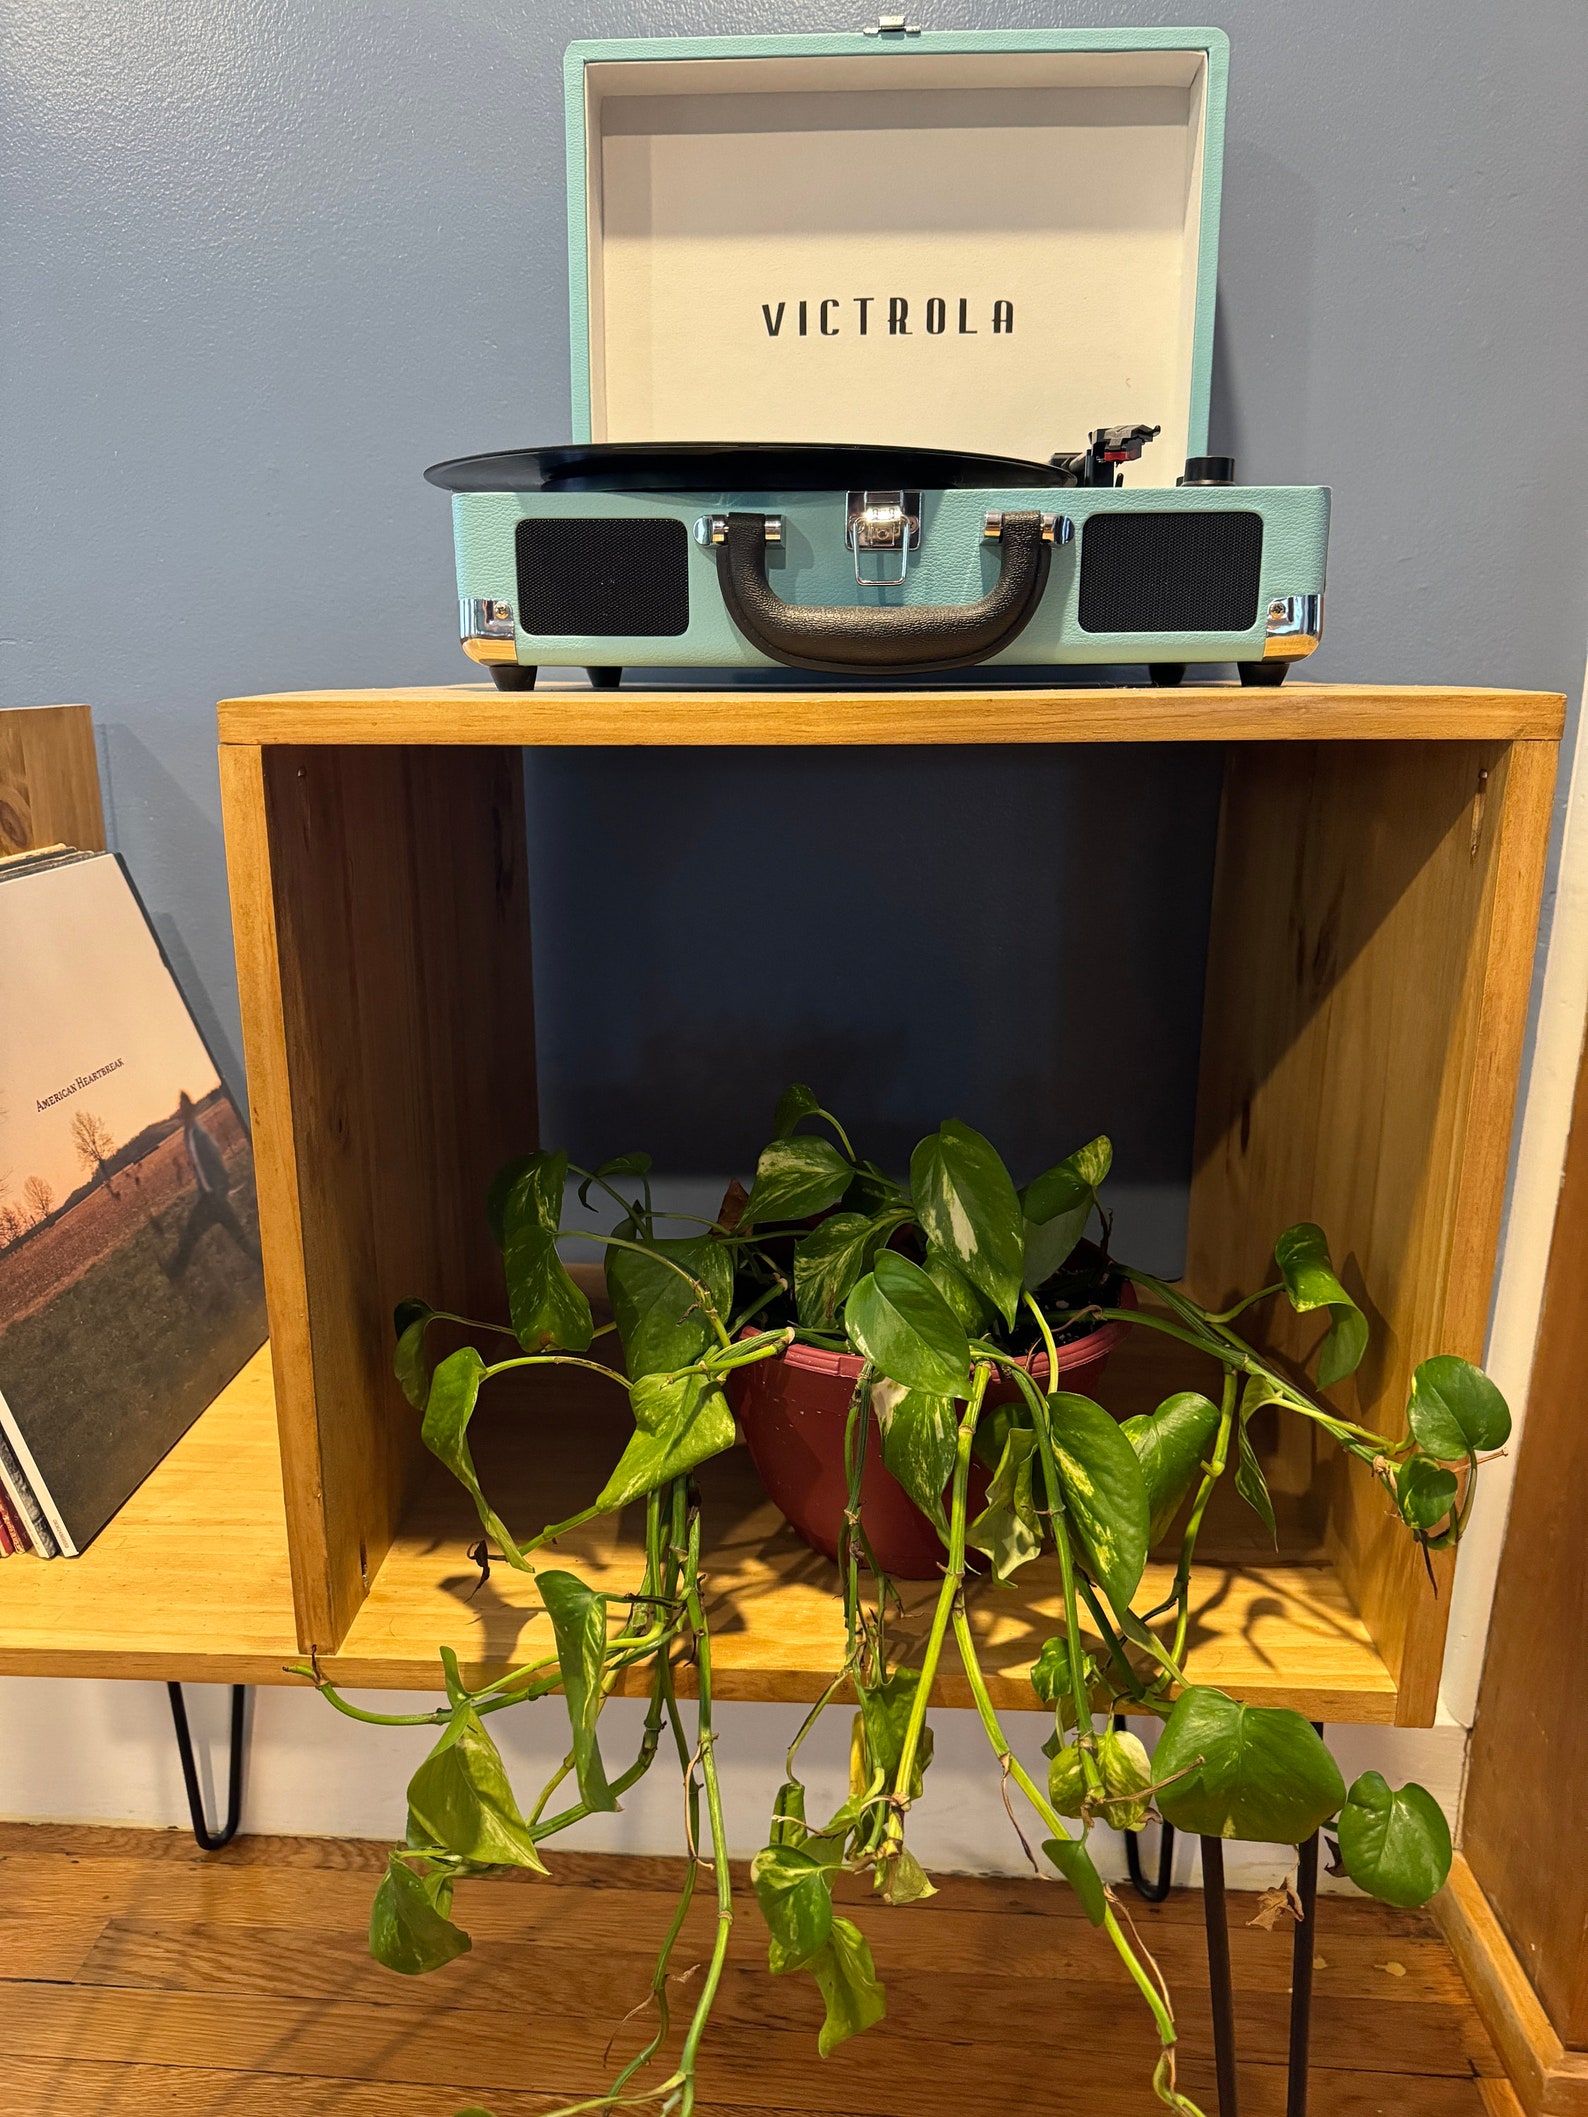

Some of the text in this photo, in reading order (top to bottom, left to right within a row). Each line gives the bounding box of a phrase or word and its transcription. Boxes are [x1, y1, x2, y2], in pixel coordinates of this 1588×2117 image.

[761, 297, 1014, 337] VICTROLA
[36, 1057, 125, 1113] AMERICAN HEARTBREAK
